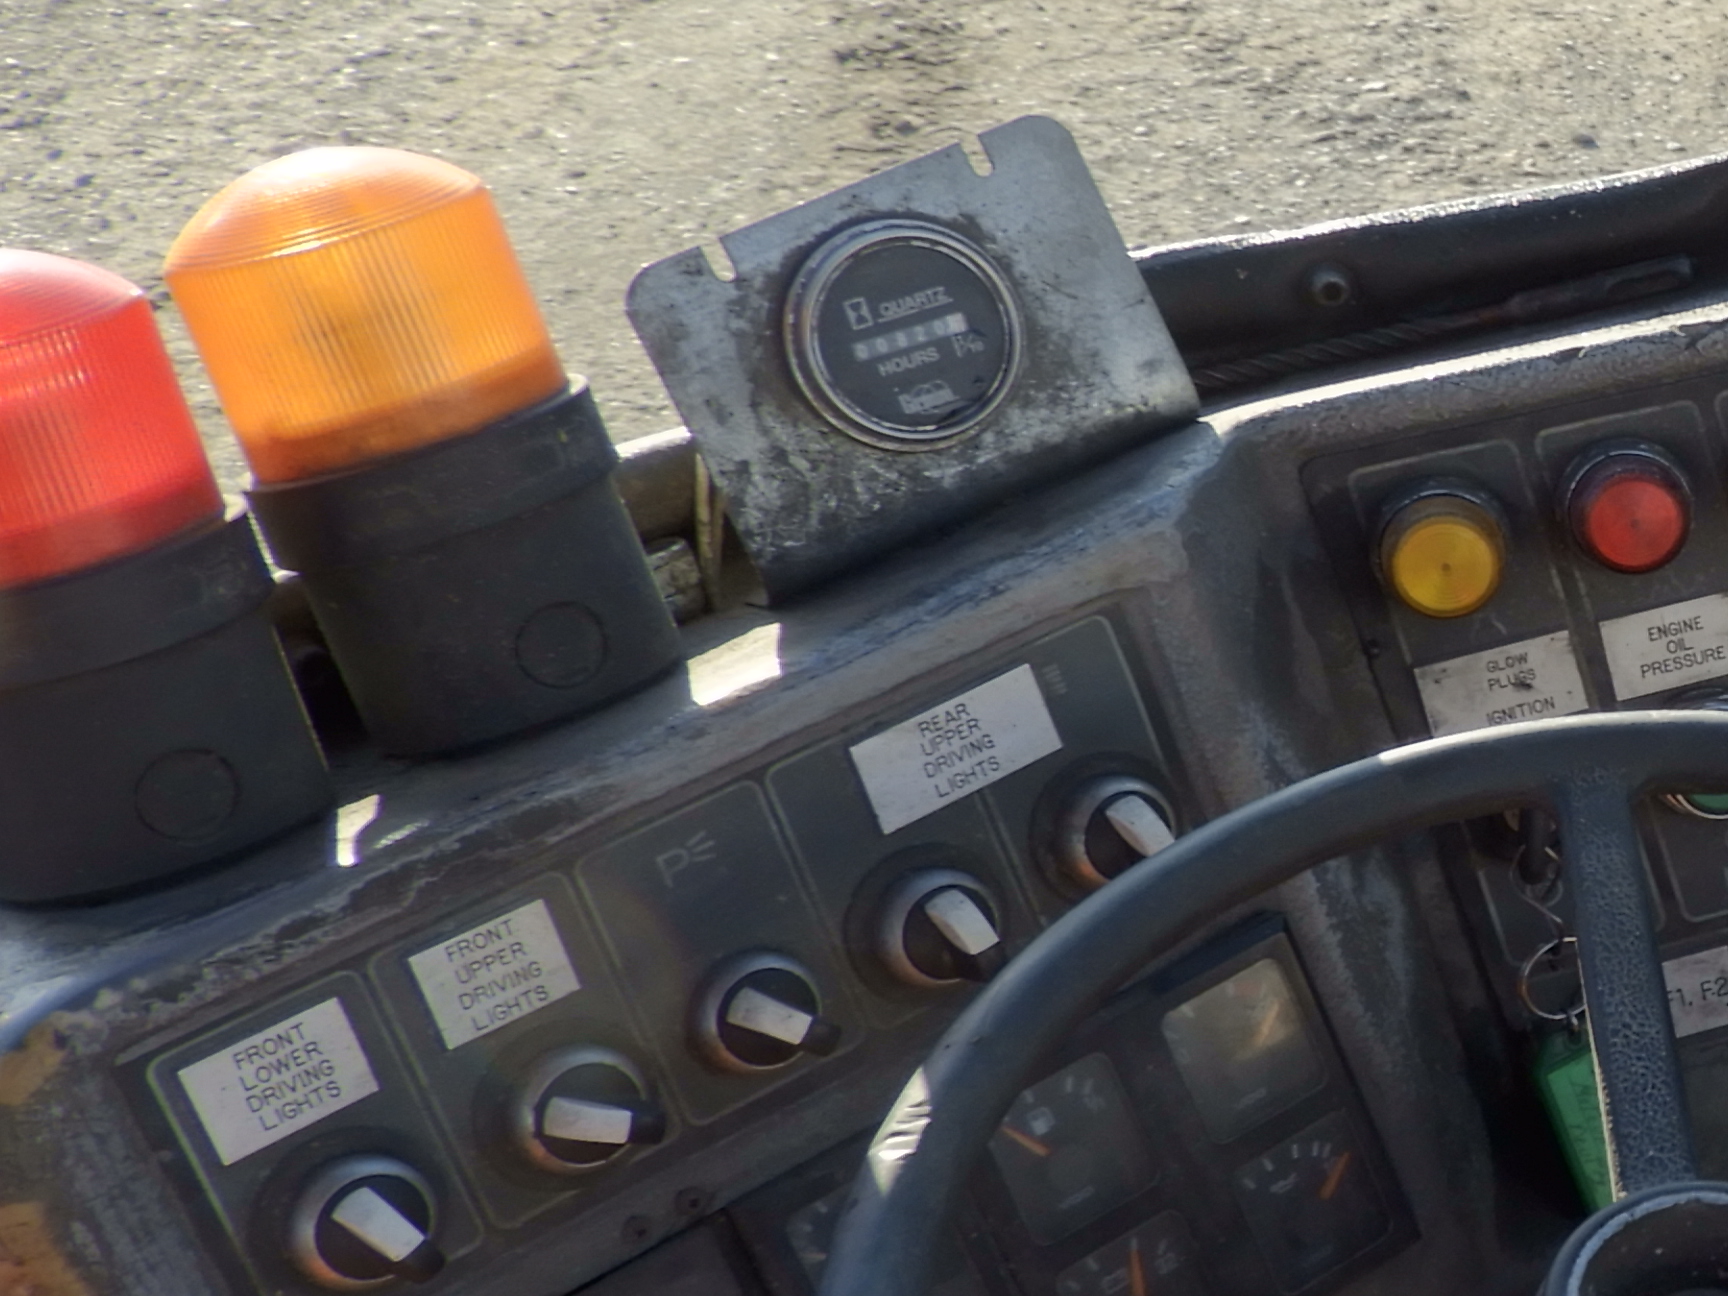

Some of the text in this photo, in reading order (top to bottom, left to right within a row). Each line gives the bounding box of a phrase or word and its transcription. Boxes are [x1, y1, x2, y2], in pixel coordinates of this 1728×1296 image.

[878, 287, 950, 318] QUARTZ
[878, 347, 940, 376] HOURS
[1647, 616, 1704, 642] ENGINE
[1666, 639, 1695, 655] OIL
[1485, 652, 1528, 674] GLOW
[1488, 668, 1536, 692] PLUGS
[1640, 646, 1726, 679] PRESSURE
[918, 703, 971, 737] REAR
[1486, 696, 1556, 727] IGNITION
[920, 718, 982, 756] UPPER
[923, 734, 996, 778] DRIVING
[934, 756, 1000, 798] LIGHTS
[444, 919, 512, 963] FRONT
[454, 942, 528, 984] UPPER
[458, 961, 542, 1011] DRIVING
[471, 985, 548, 1031] LIGHTS
[233, 1023, 305, 1070] FRONT
[238, 1042, 324, 1091] LOWER
[244, 1060, 336, 1114] DRIVING
[259, 1081, 342, 1131] LIGHTS
